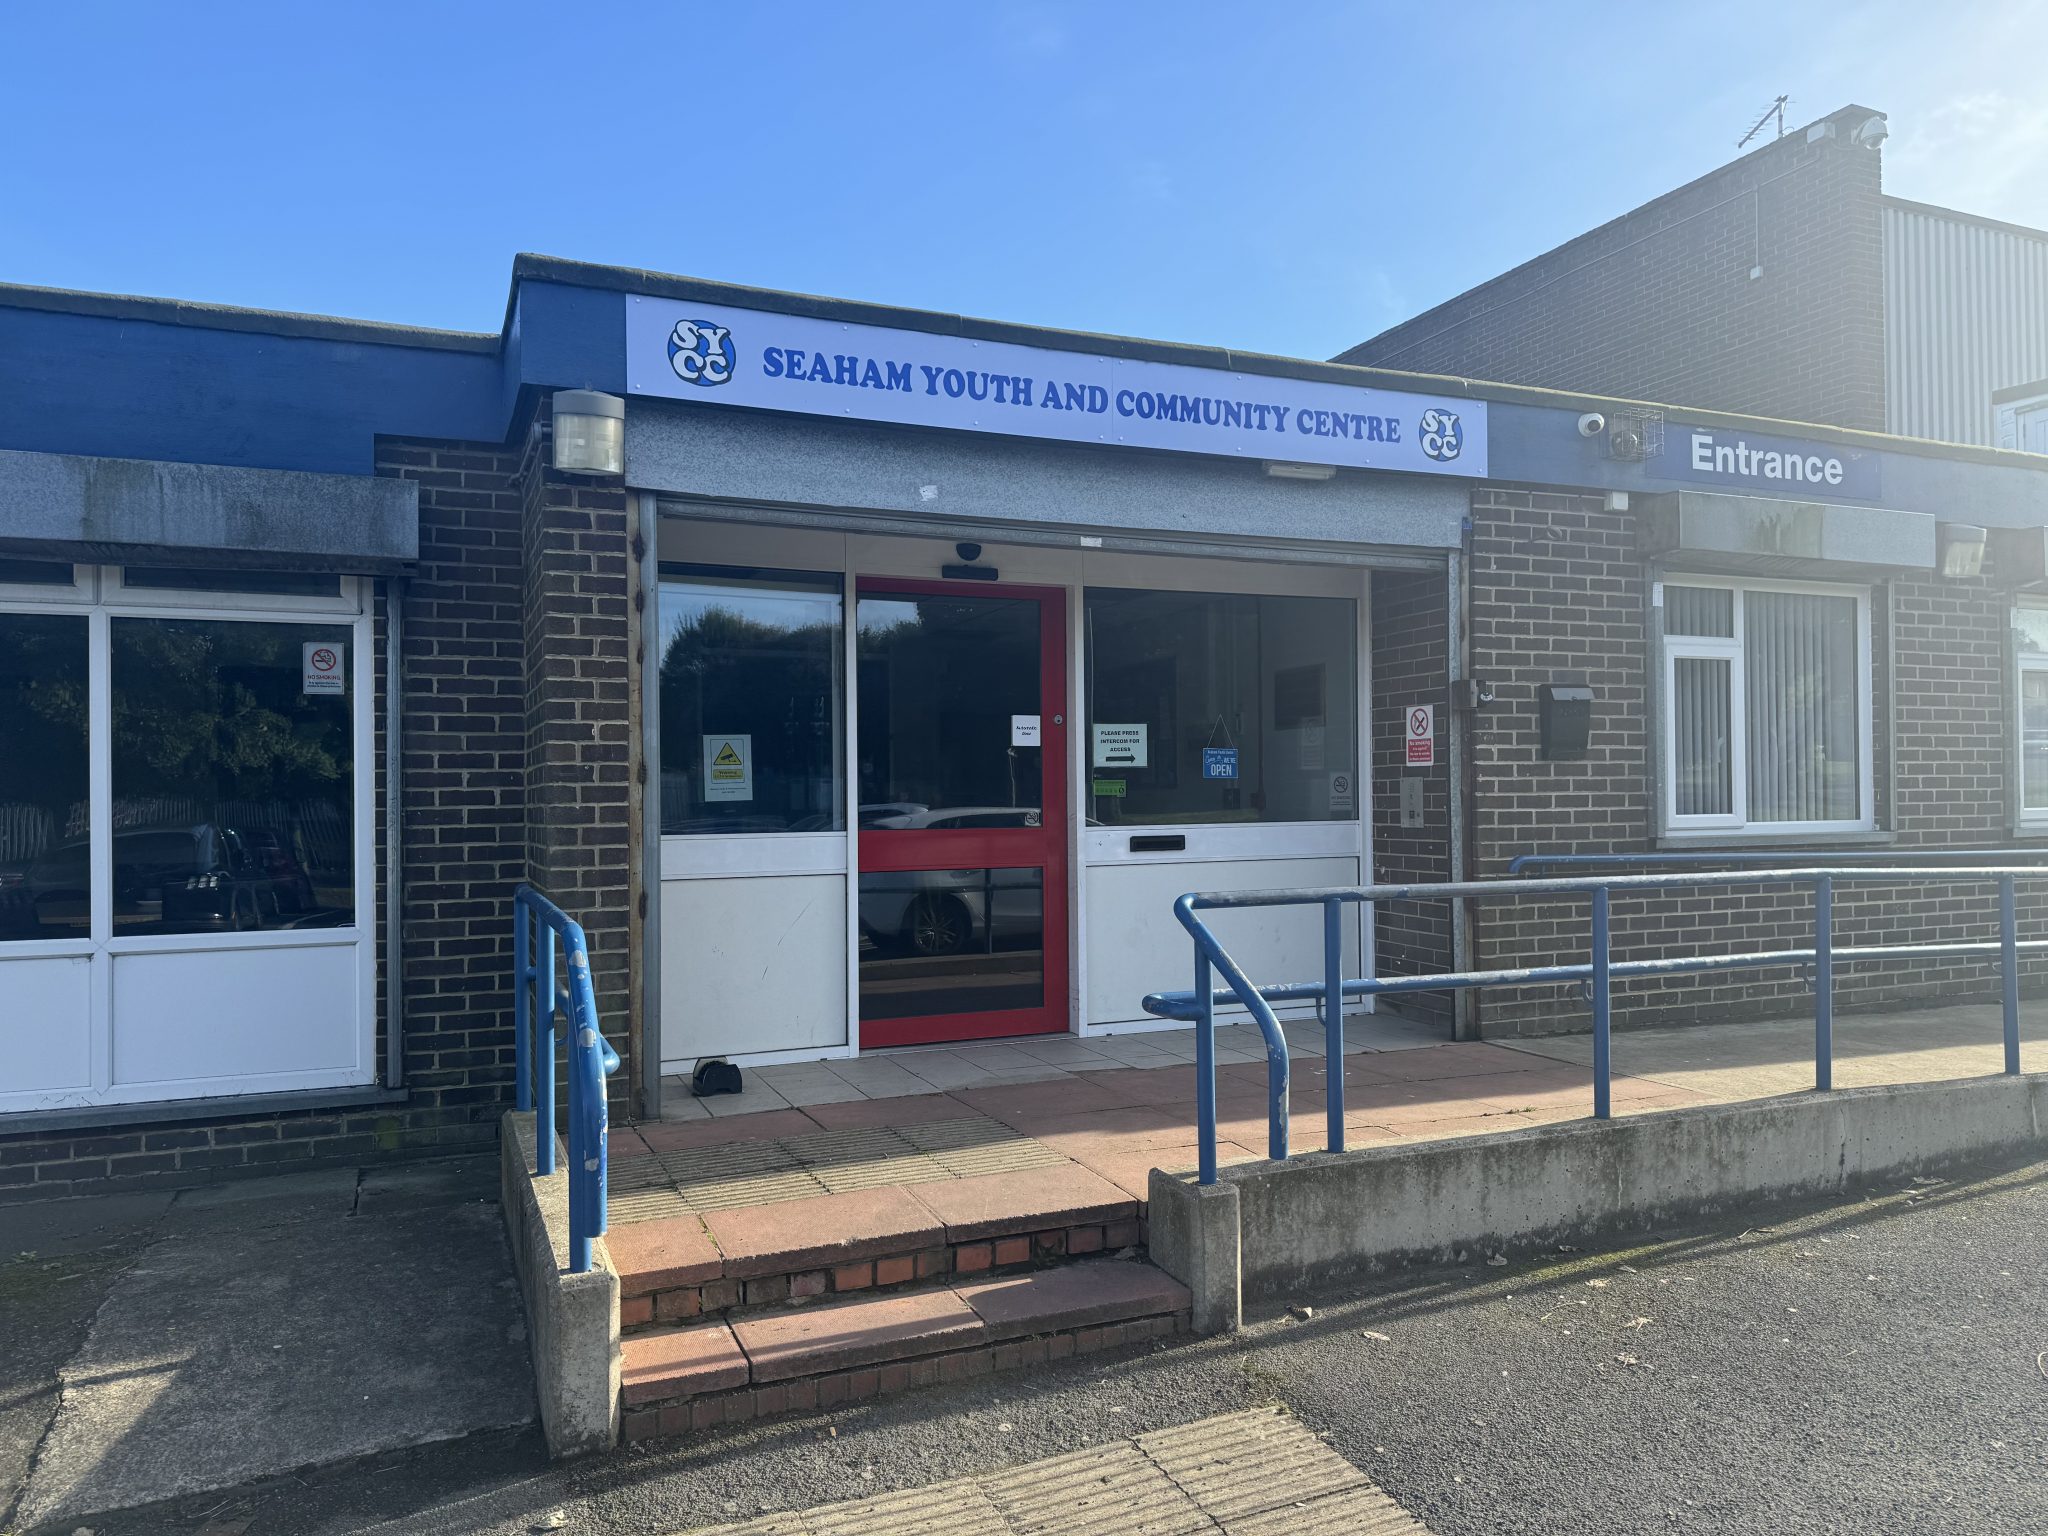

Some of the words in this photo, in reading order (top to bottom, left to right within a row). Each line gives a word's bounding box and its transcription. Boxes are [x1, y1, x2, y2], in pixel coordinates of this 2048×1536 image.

[763, 346, 912, 392] SEAHAM
[919, 365, 1033, 407] YOUTH
[1040, 381, 1109, 414] AND
[1116, 389, 1290, 433] COMMUNITY
[1297, 409, 1401, 444] CENTRE
[1691, 434, 1843, 485] Entrance
[1210, 763, 1232, 776] OPEN
